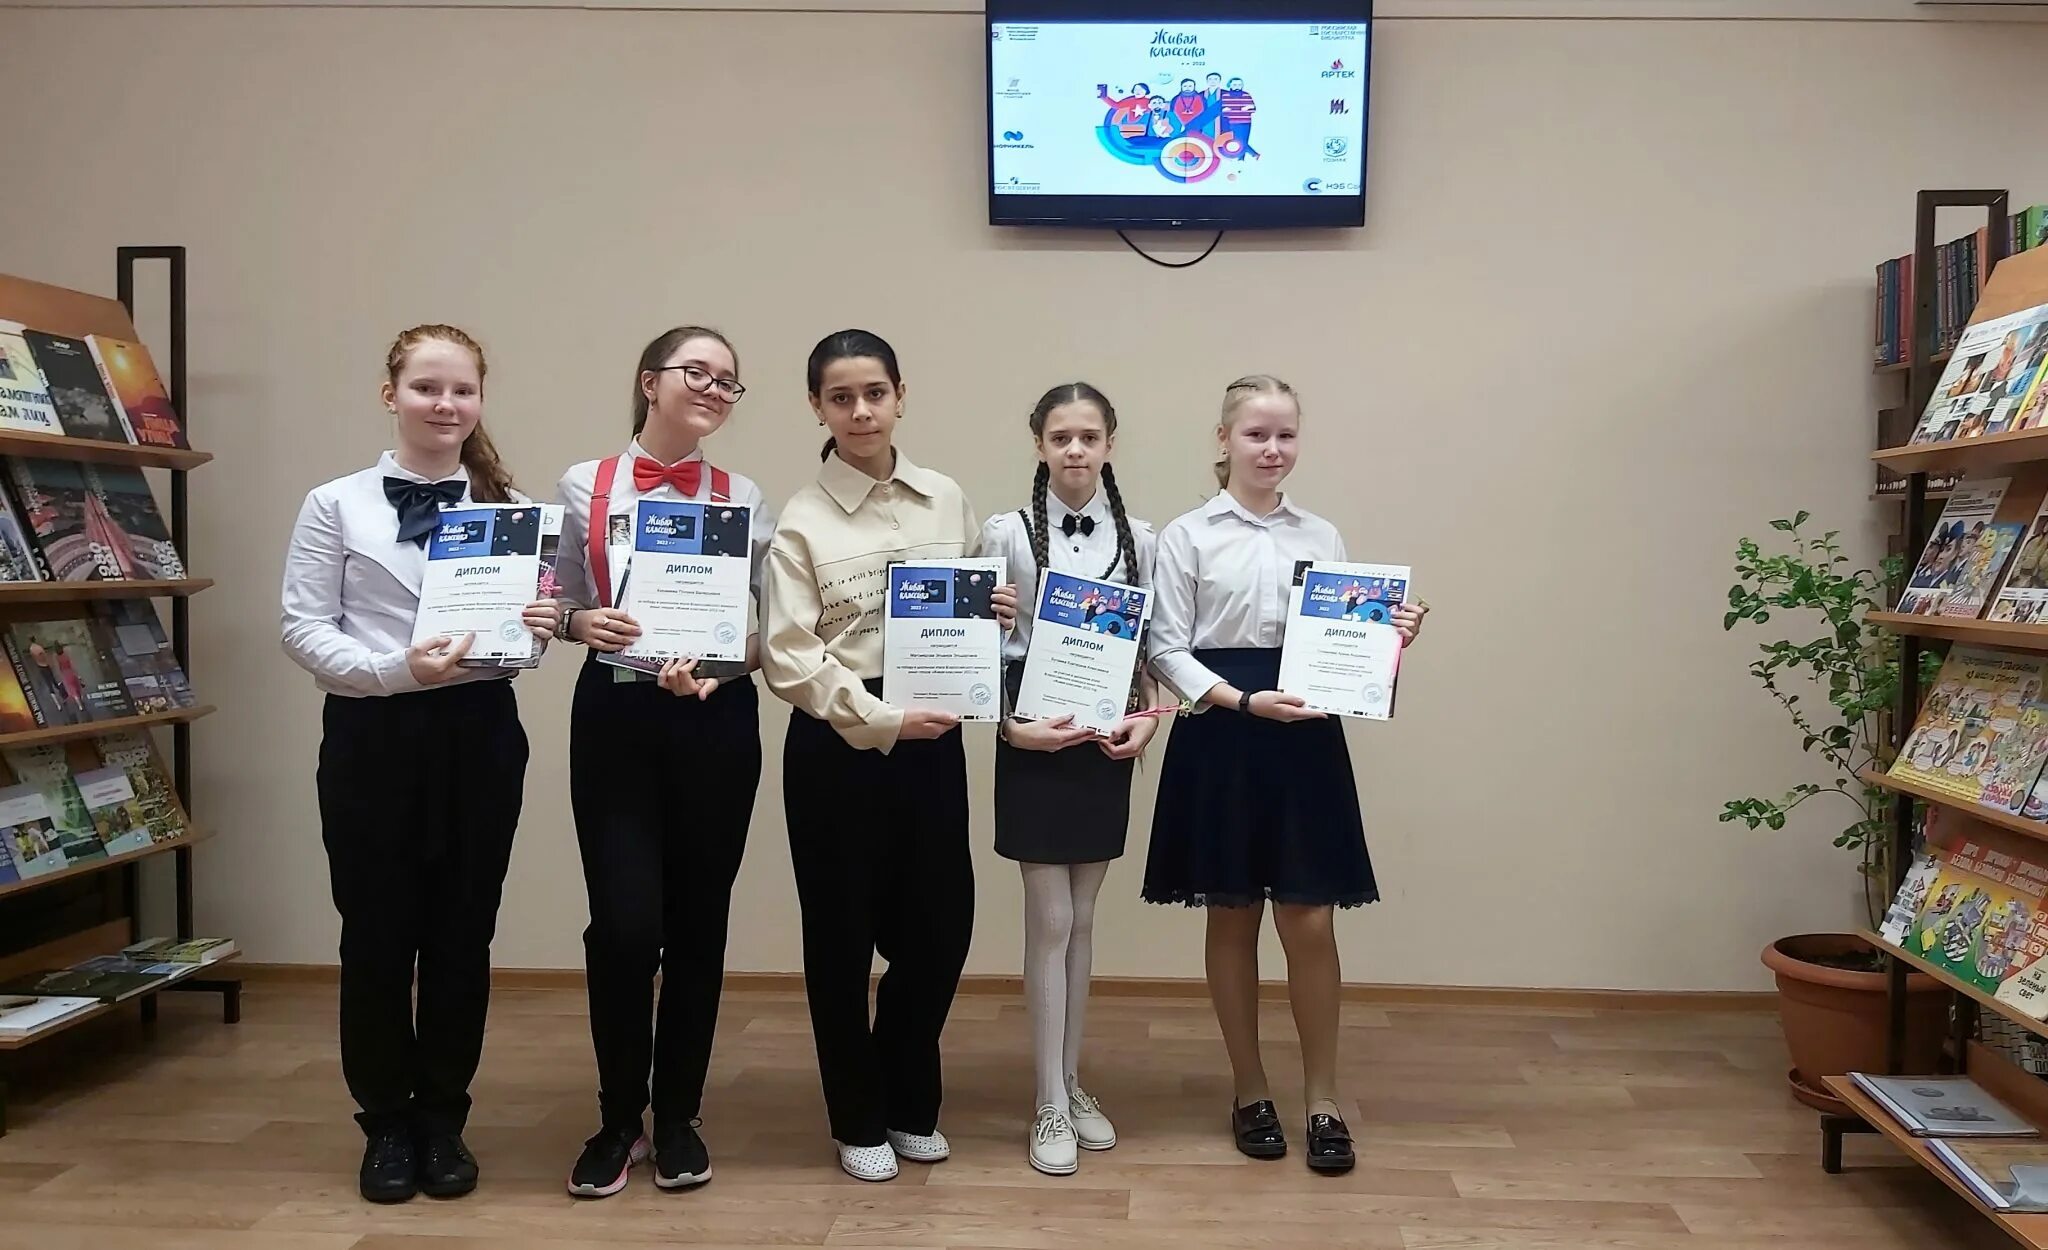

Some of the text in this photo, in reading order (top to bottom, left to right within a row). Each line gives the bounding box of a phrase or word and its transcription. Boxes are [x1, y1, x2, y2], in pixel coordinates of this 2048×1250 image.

[1150, 28, 1197, 45] Живая
[1150, 46, 1205, 58] классика
[1321, 70, 1355, 78] АРТЕК
[646, 513, 674, 526] Живая
[645, 525, 677, 535] классика
[454, 566, 501, 578] ДИПЛОМ
[665, 563, 713, 575] ДИПЛОМ
[820, 581, 833, 593] ght
[849, 572, 866, 582] still
[900, 580, 926, 592] Живая
[1051, 586, 1076, 601] Живая
[1311, 583, 1336, 595] Живая
[847, 611, 862, 620] still
[865, 606, 880, 618] young
[859, 627, 880, 636] young
[920, 628, 965, 639] ДИПЛОМ
[1324, 628, 1367, 640] ДИПЛОМ
[1061, 636, 1104, 652] ДИПЛОМ
[2033, 970, 2042, 981] на
[2017, 976, 2047, 994] зеленый
[2019, 988, 2035, 1000] свет
